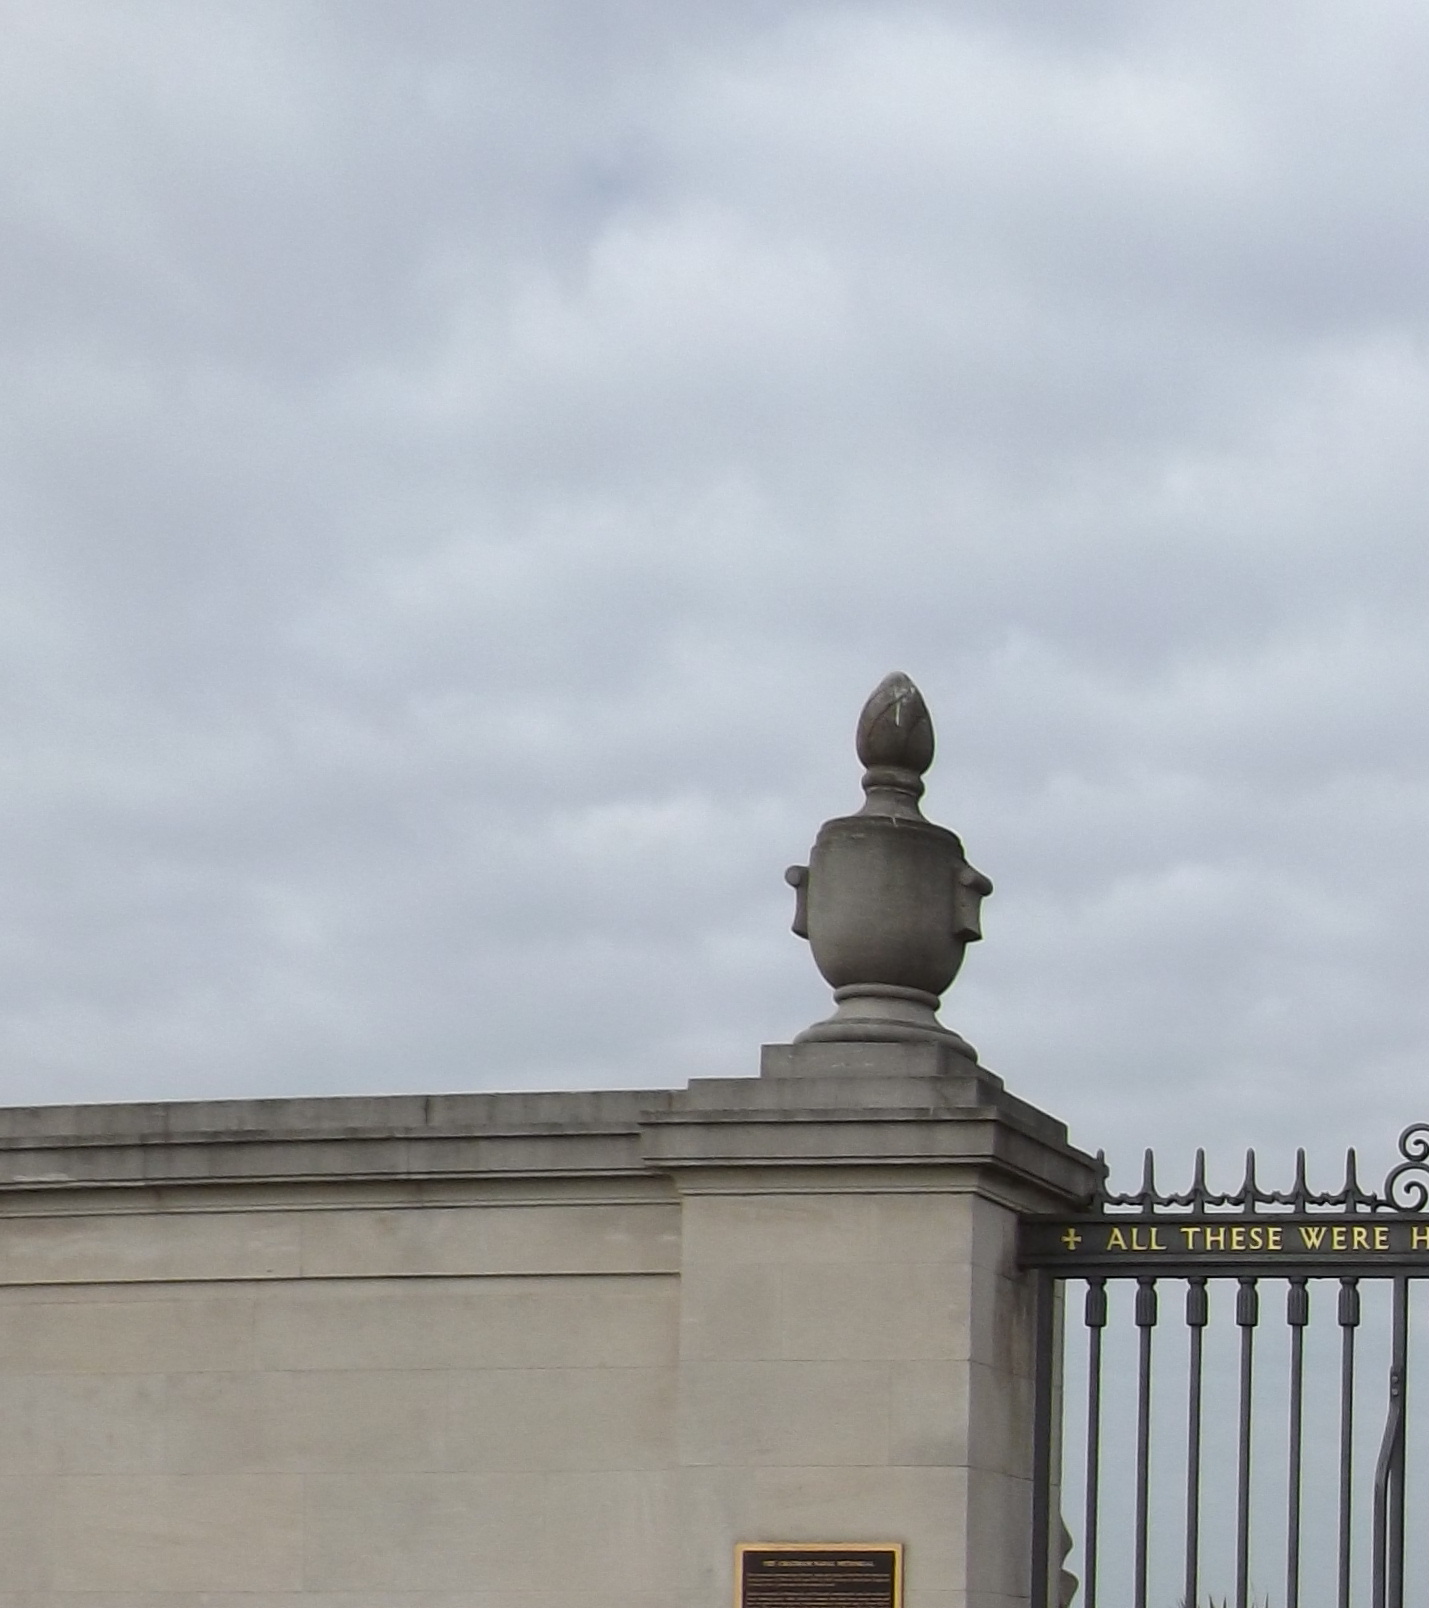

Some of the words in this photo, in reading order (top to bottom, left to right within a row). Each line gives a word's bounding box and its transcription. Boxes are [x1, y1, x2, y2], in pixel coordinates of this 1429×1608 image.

[1106, 1227, 1167, 1251] ALL
[1180, 1226, 1283, 1251] THESE
[1300, 1226, 1389, 1251] WERE
